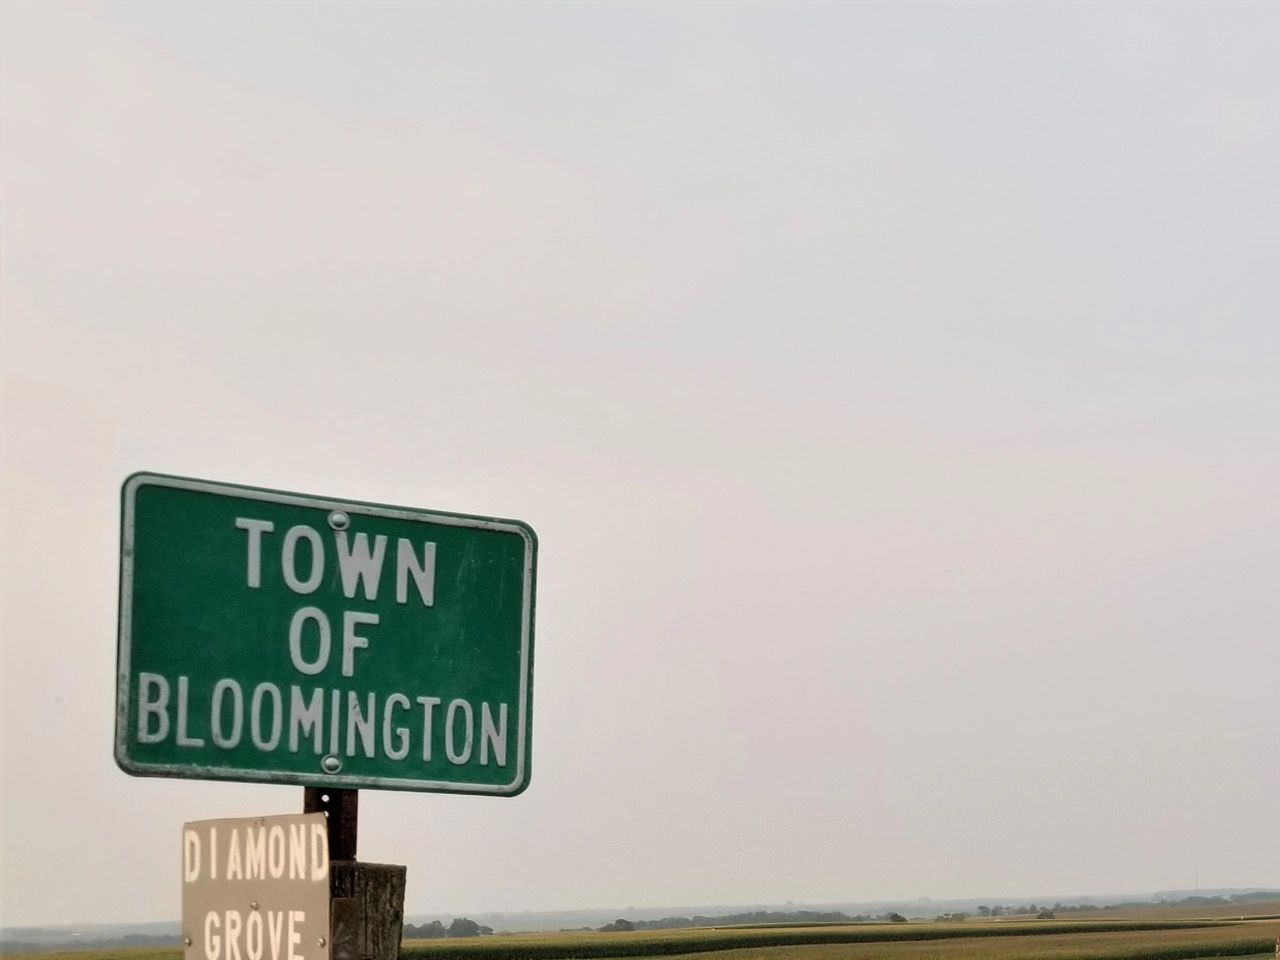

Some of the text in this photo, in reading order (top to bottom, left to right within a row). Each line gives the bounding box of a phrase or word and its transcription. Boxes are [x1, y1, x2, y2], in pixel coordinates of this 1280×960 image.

[235, 517, 437, 606] TOWN
[289, 606, 380, 677] OF
[137, 672, 508, 767] BLOOMINGTON
[184, 823, 330, 882] DIAMOND
